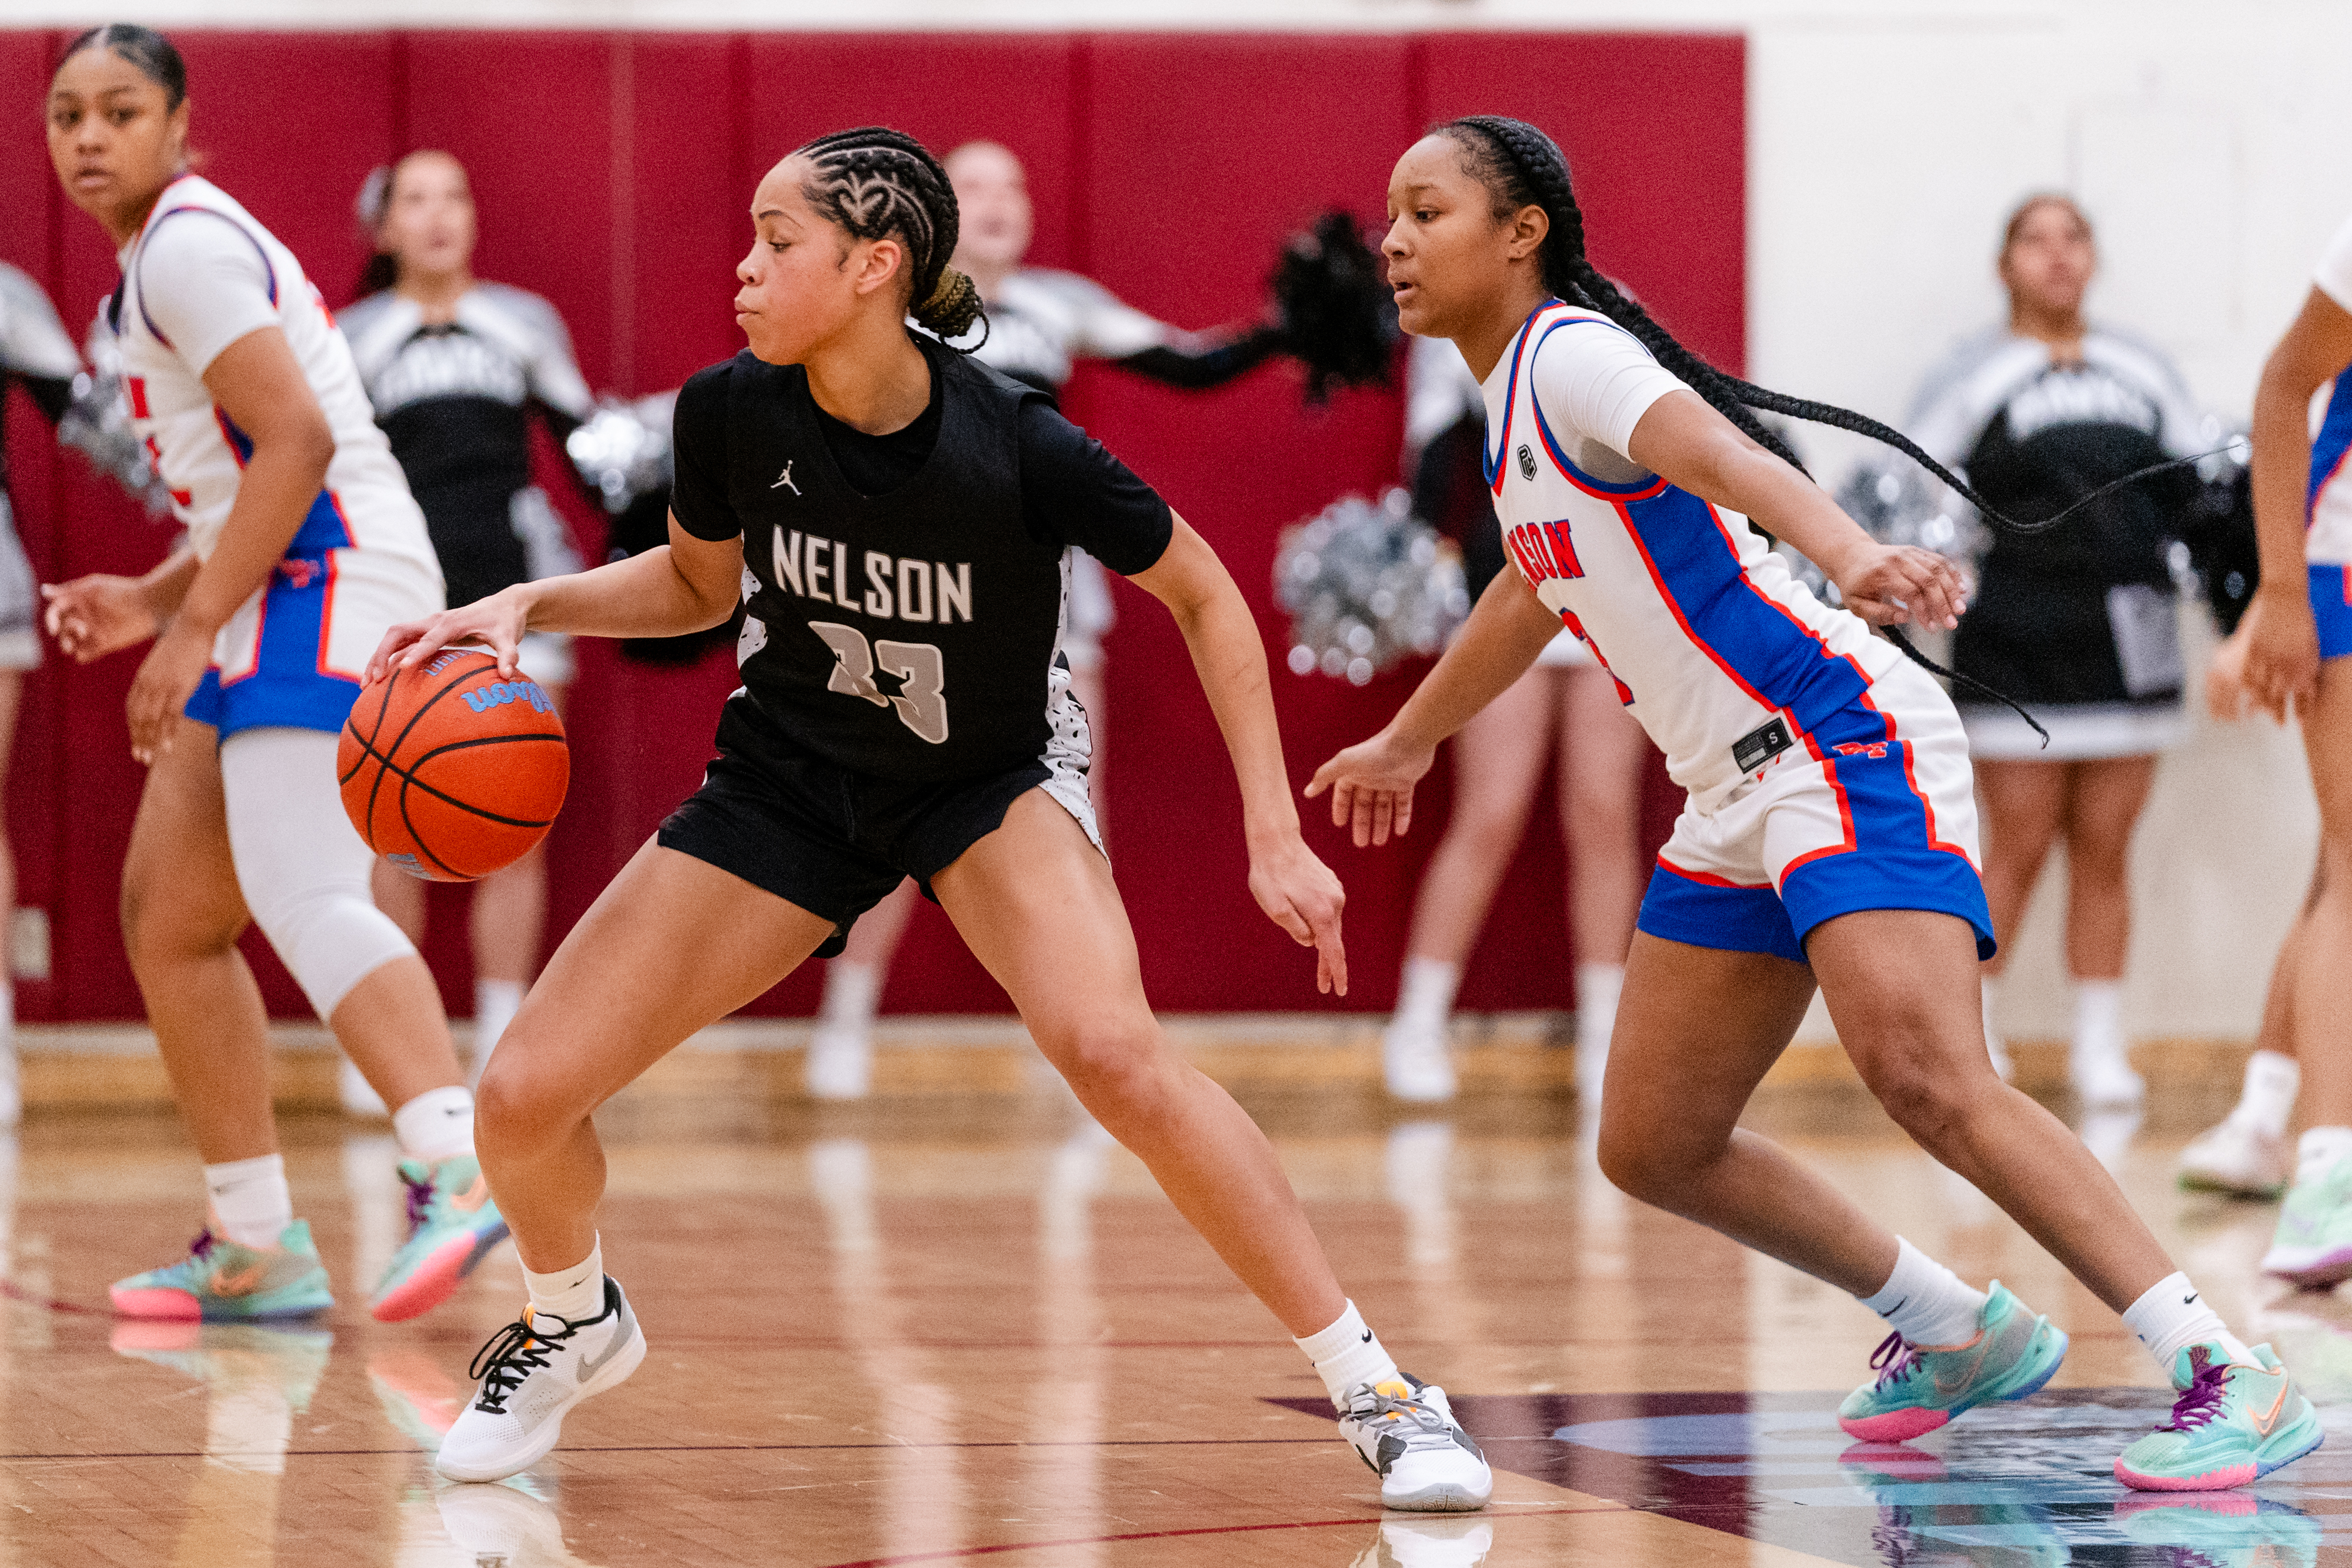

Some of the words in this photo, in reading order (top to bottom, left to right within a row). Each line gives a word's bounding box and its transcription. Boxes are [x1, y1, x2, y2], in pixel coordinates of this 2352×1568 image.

[772, 524, 973, 624] NELSON
[461, 681, 559, 718] ilson
[1769, 732, 1779, 745] S
